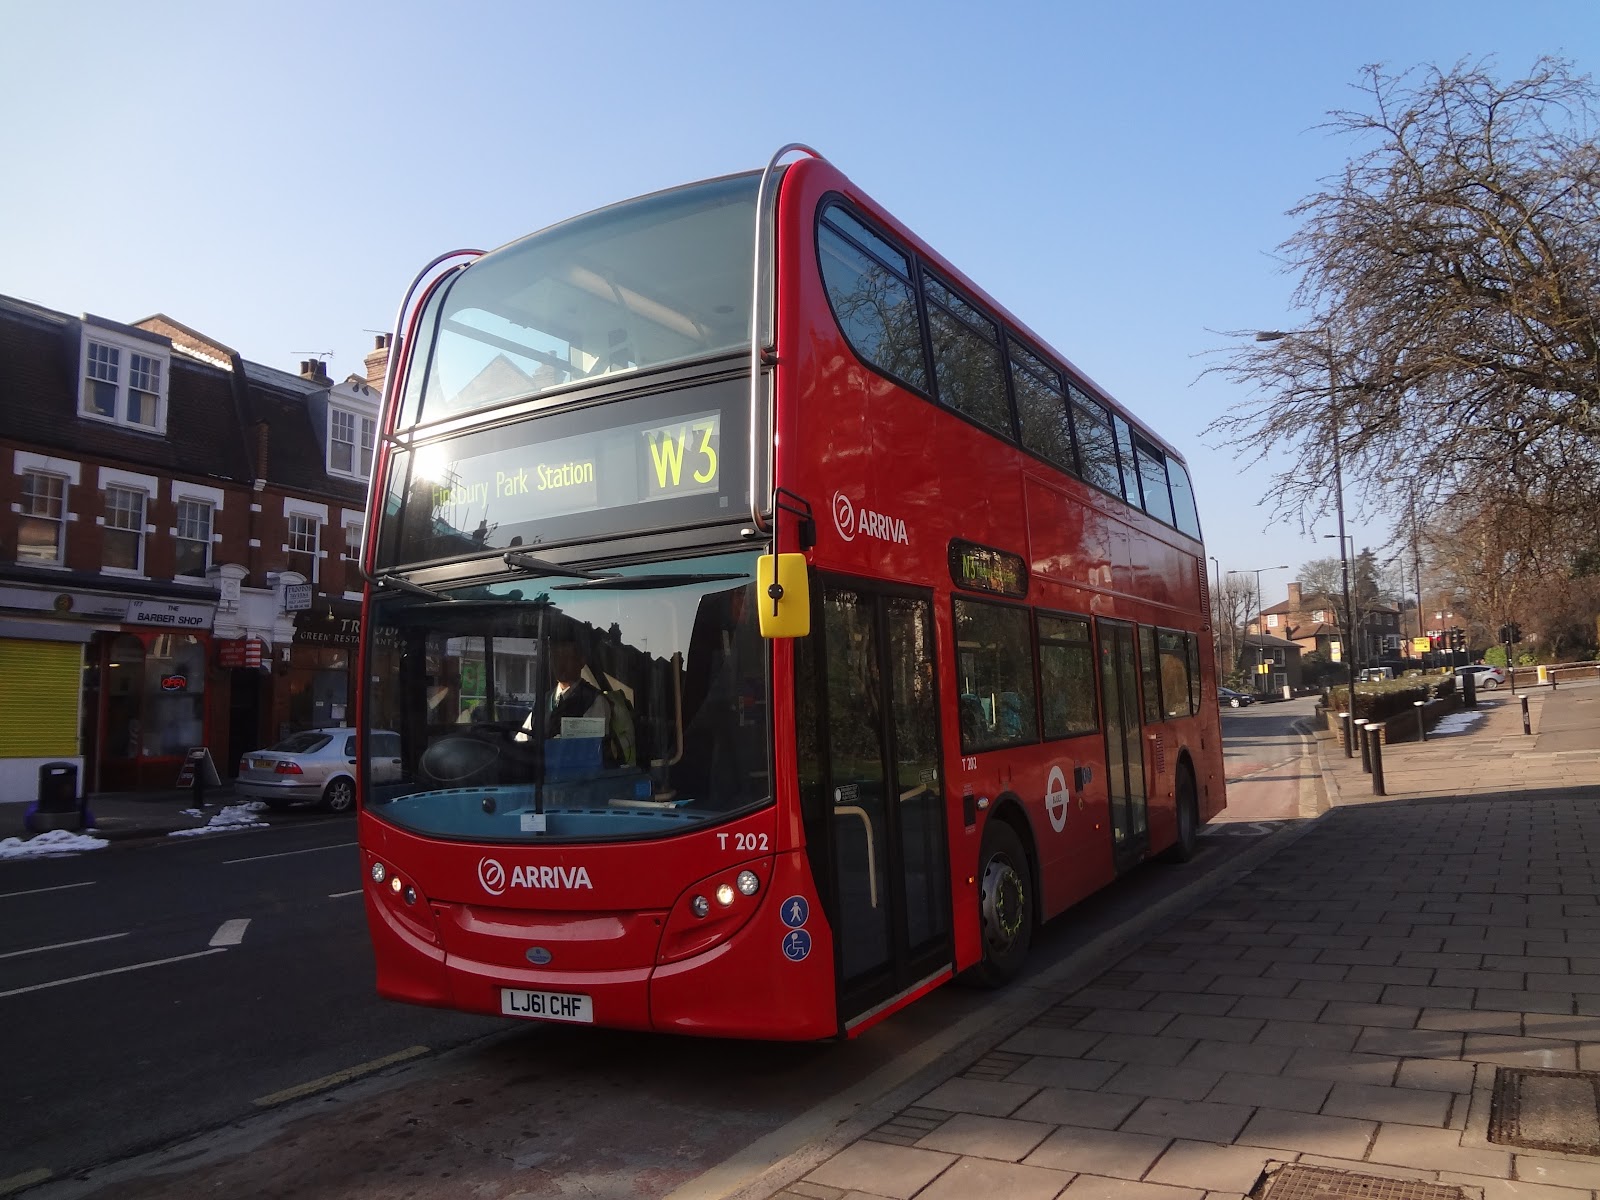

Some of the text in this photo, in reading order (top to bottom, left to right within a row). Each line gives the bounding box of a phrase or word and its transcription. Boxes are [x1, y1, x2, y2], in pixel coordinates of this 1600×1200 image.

[647, 421, 718, 489] W3
[496, 467, 529, 498] Park
[537, 459, 593, 491] Station
[858, 508, 909, 545] ARRIVA
[137, 612, 203, 626] BARBER SHOP
[162, 678, 186, 688] OPEN
[717, 832, 769, 851] T 202
[510, 865, 594, 890] ARRIVA
[510, 991, 582, 1017] LJ61 CHF
